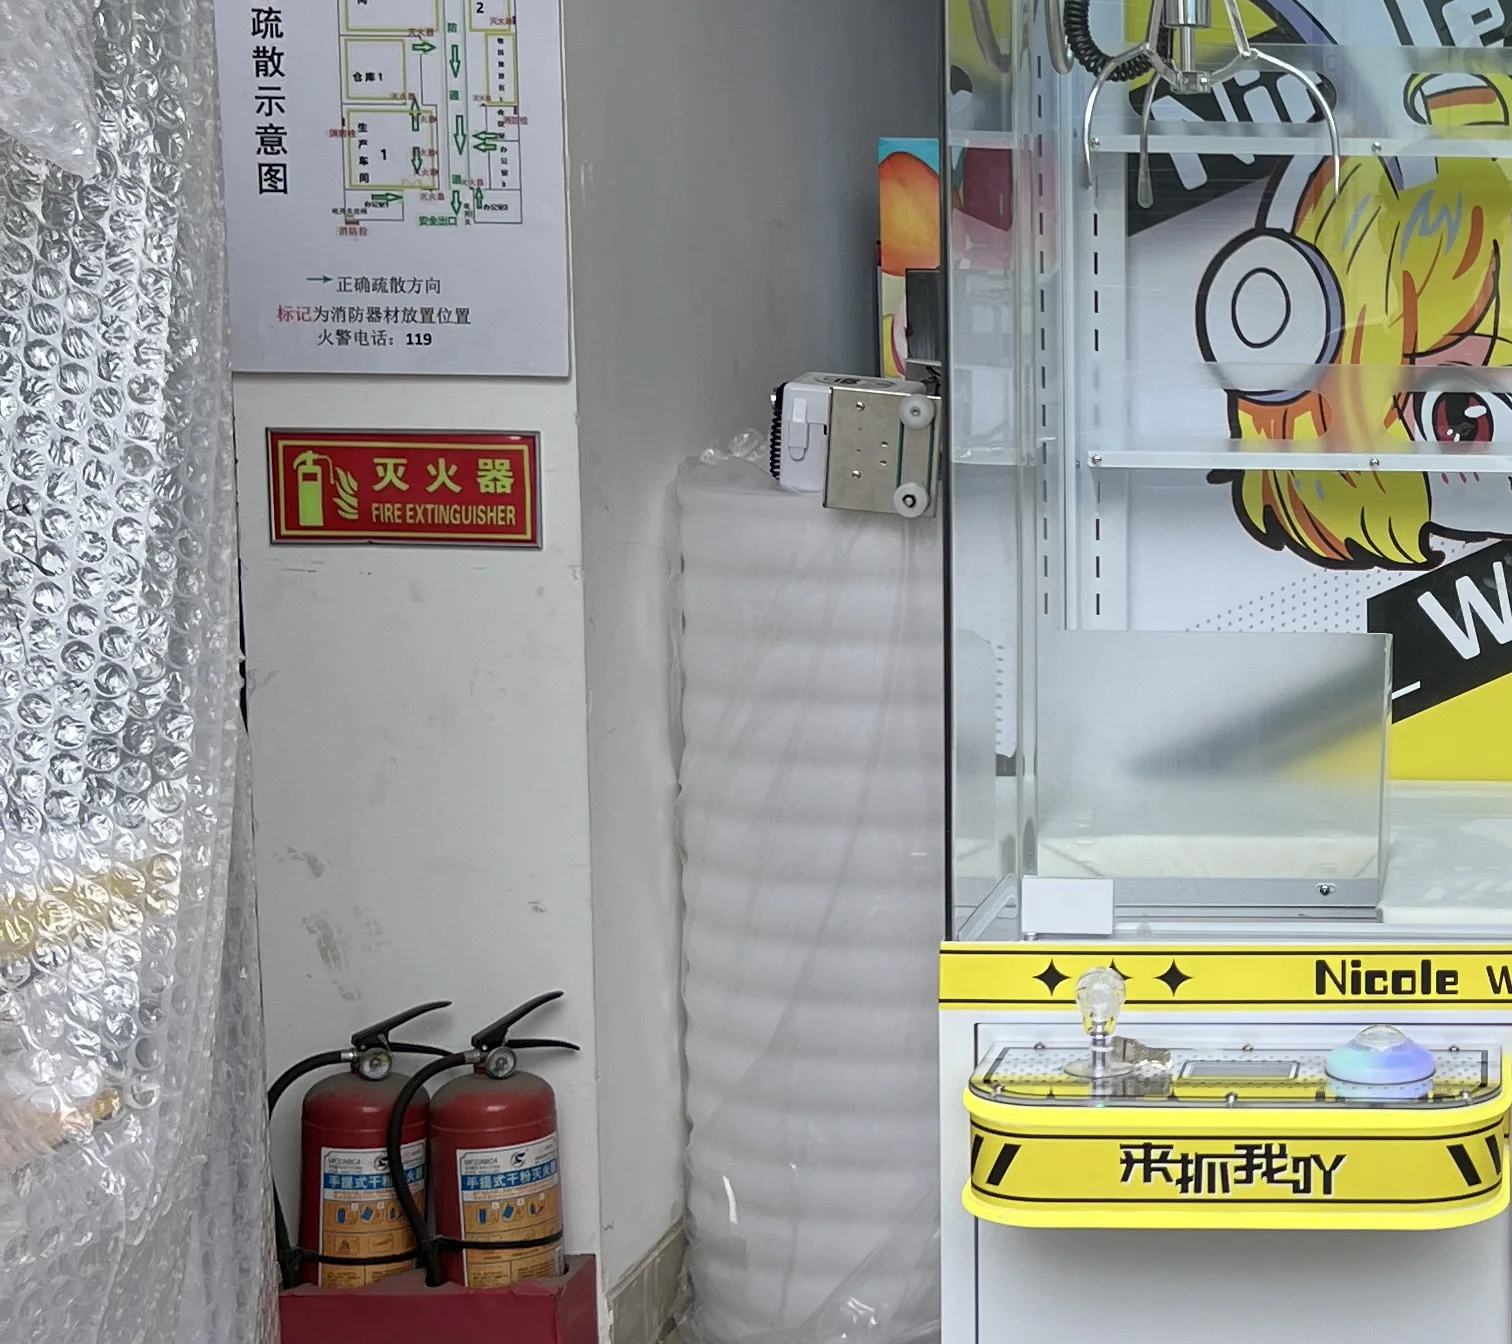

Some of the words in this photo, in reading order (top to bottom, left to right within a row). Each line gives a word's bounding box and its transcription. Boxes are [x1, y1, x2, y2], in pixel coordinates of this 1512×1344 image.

[419, 216, 457, 226] 安全出口
[336, 276, 441, 295] 正确疏散方向
[276, 306, 472, 325] 标记为消防器材放置位置
[372, 458, 515, 494] 灭火器
[372, 503, 402, 523] FIRE
[406, 504, 516, 525] EXTINGUISHER
[1315, 960, 1459, 996] Nicole
